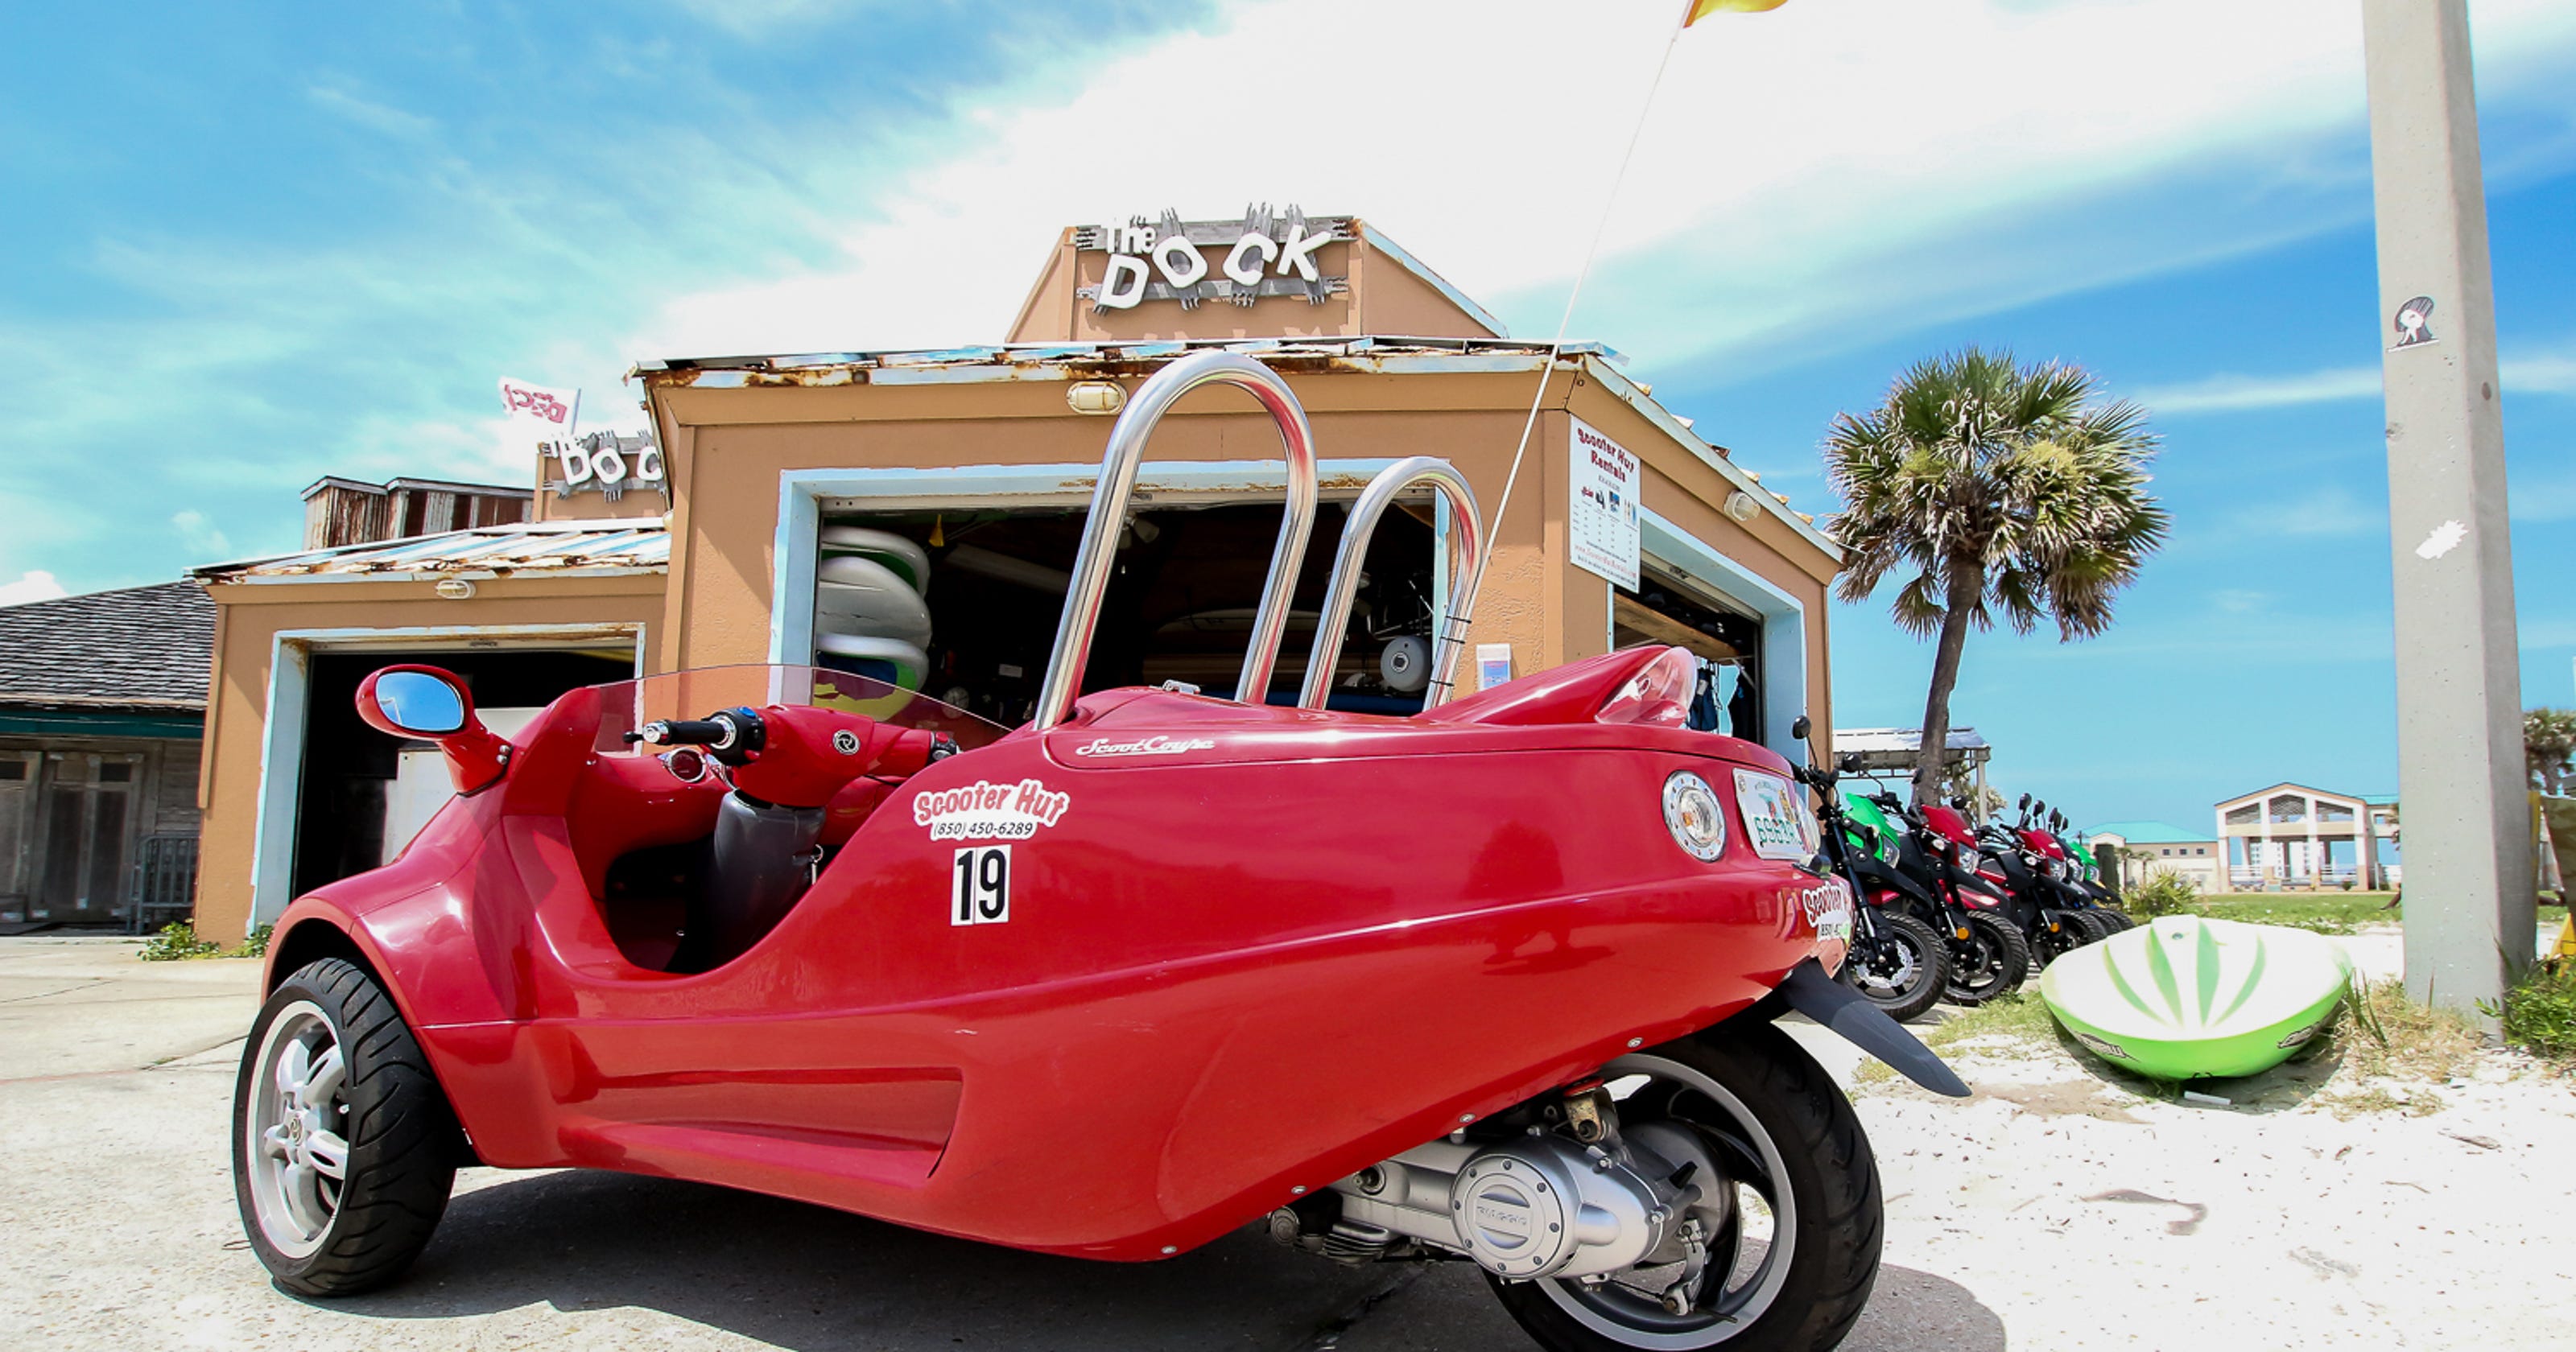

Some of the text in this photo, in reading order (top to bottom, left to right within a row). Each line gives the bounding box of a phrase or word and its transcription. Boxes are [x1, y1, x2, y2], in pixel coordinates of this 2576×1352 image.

[1100, 215, 1157, 254] The
[1098, 225, 1331, 309] DOCK
[916, 782, 1066, 822] Scooter Hut
[934, 822, 1034, 837] (850) 450-6289
[956, 848, 1007, 921] 19
